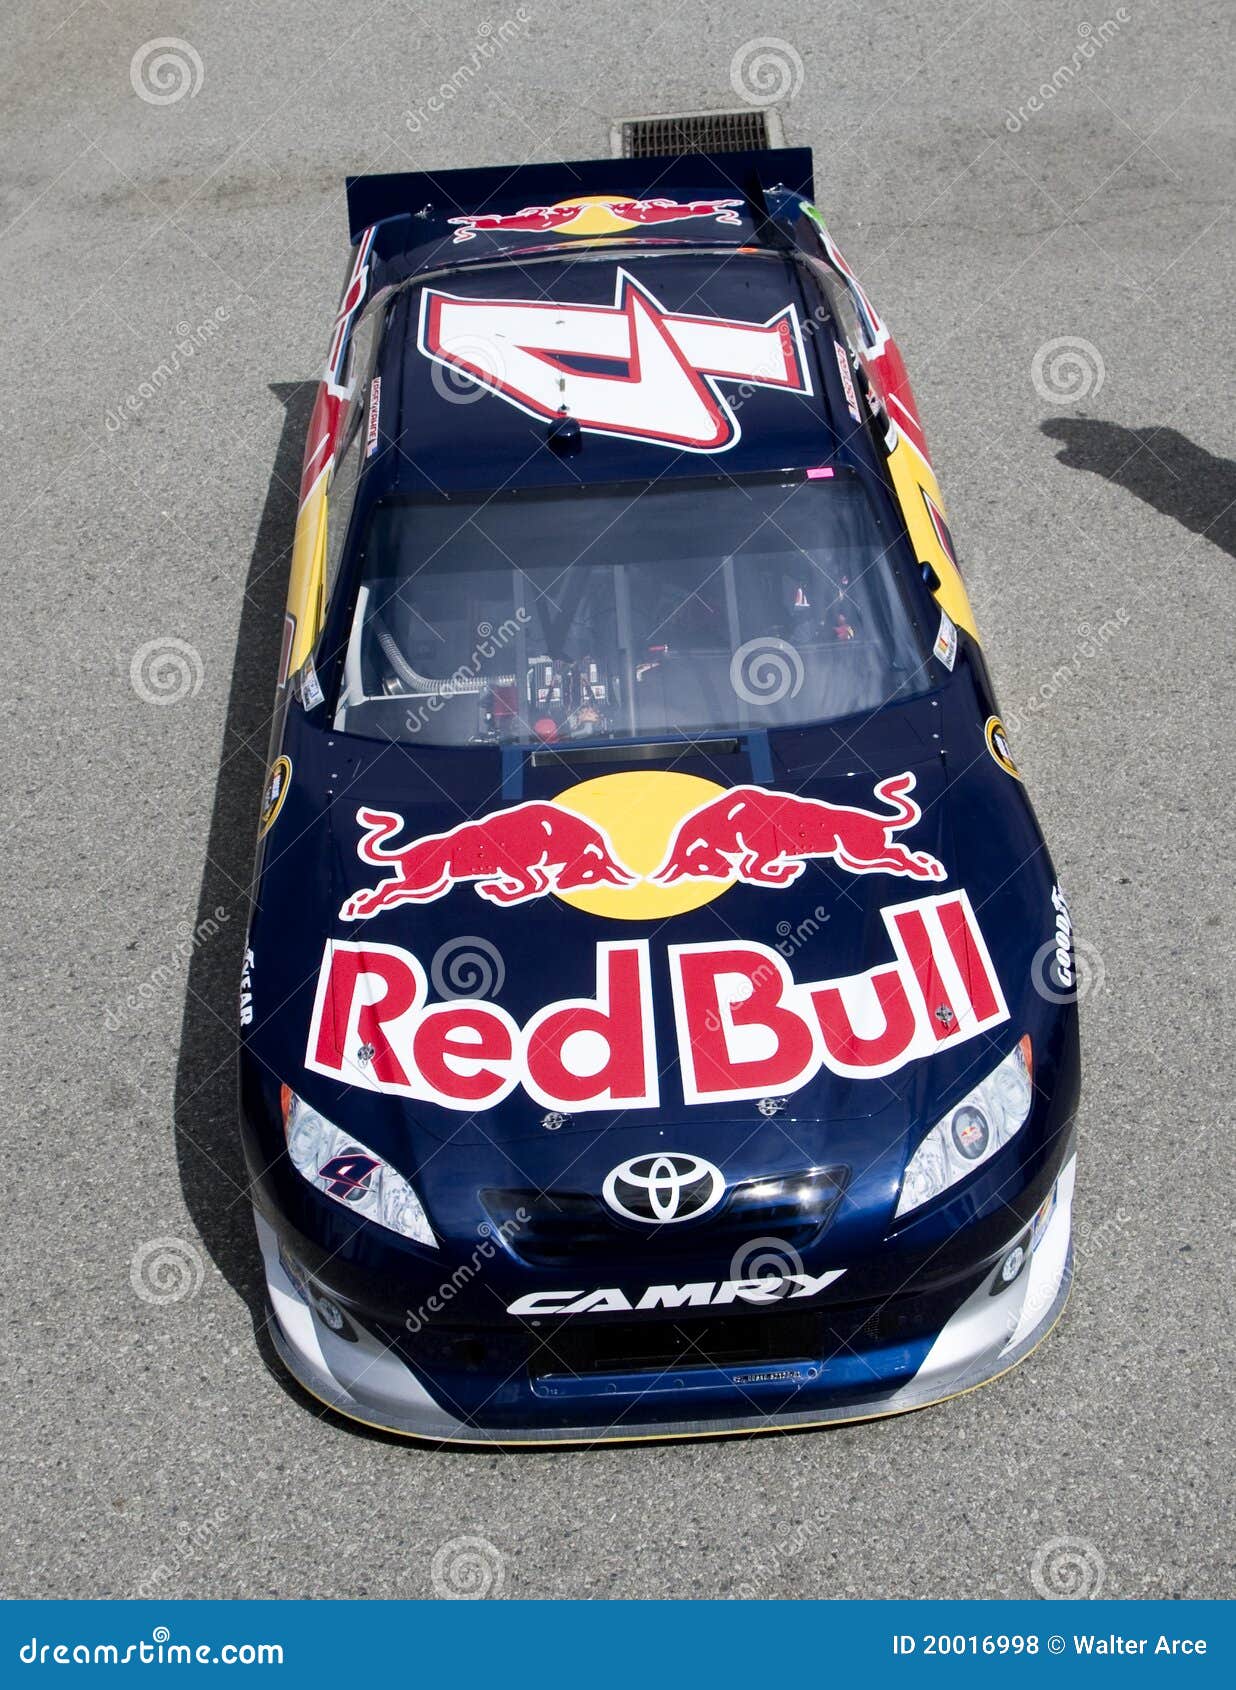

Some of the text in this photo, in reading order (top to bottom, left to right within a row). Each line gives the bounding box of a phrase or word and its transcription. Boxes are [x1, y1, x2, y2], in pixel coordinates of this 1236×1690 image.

[418, 268, 814, 453] 4
[312, 898, 1002, 1103] Red Bull
[506, 1268, 848, 1315] CAMRY
